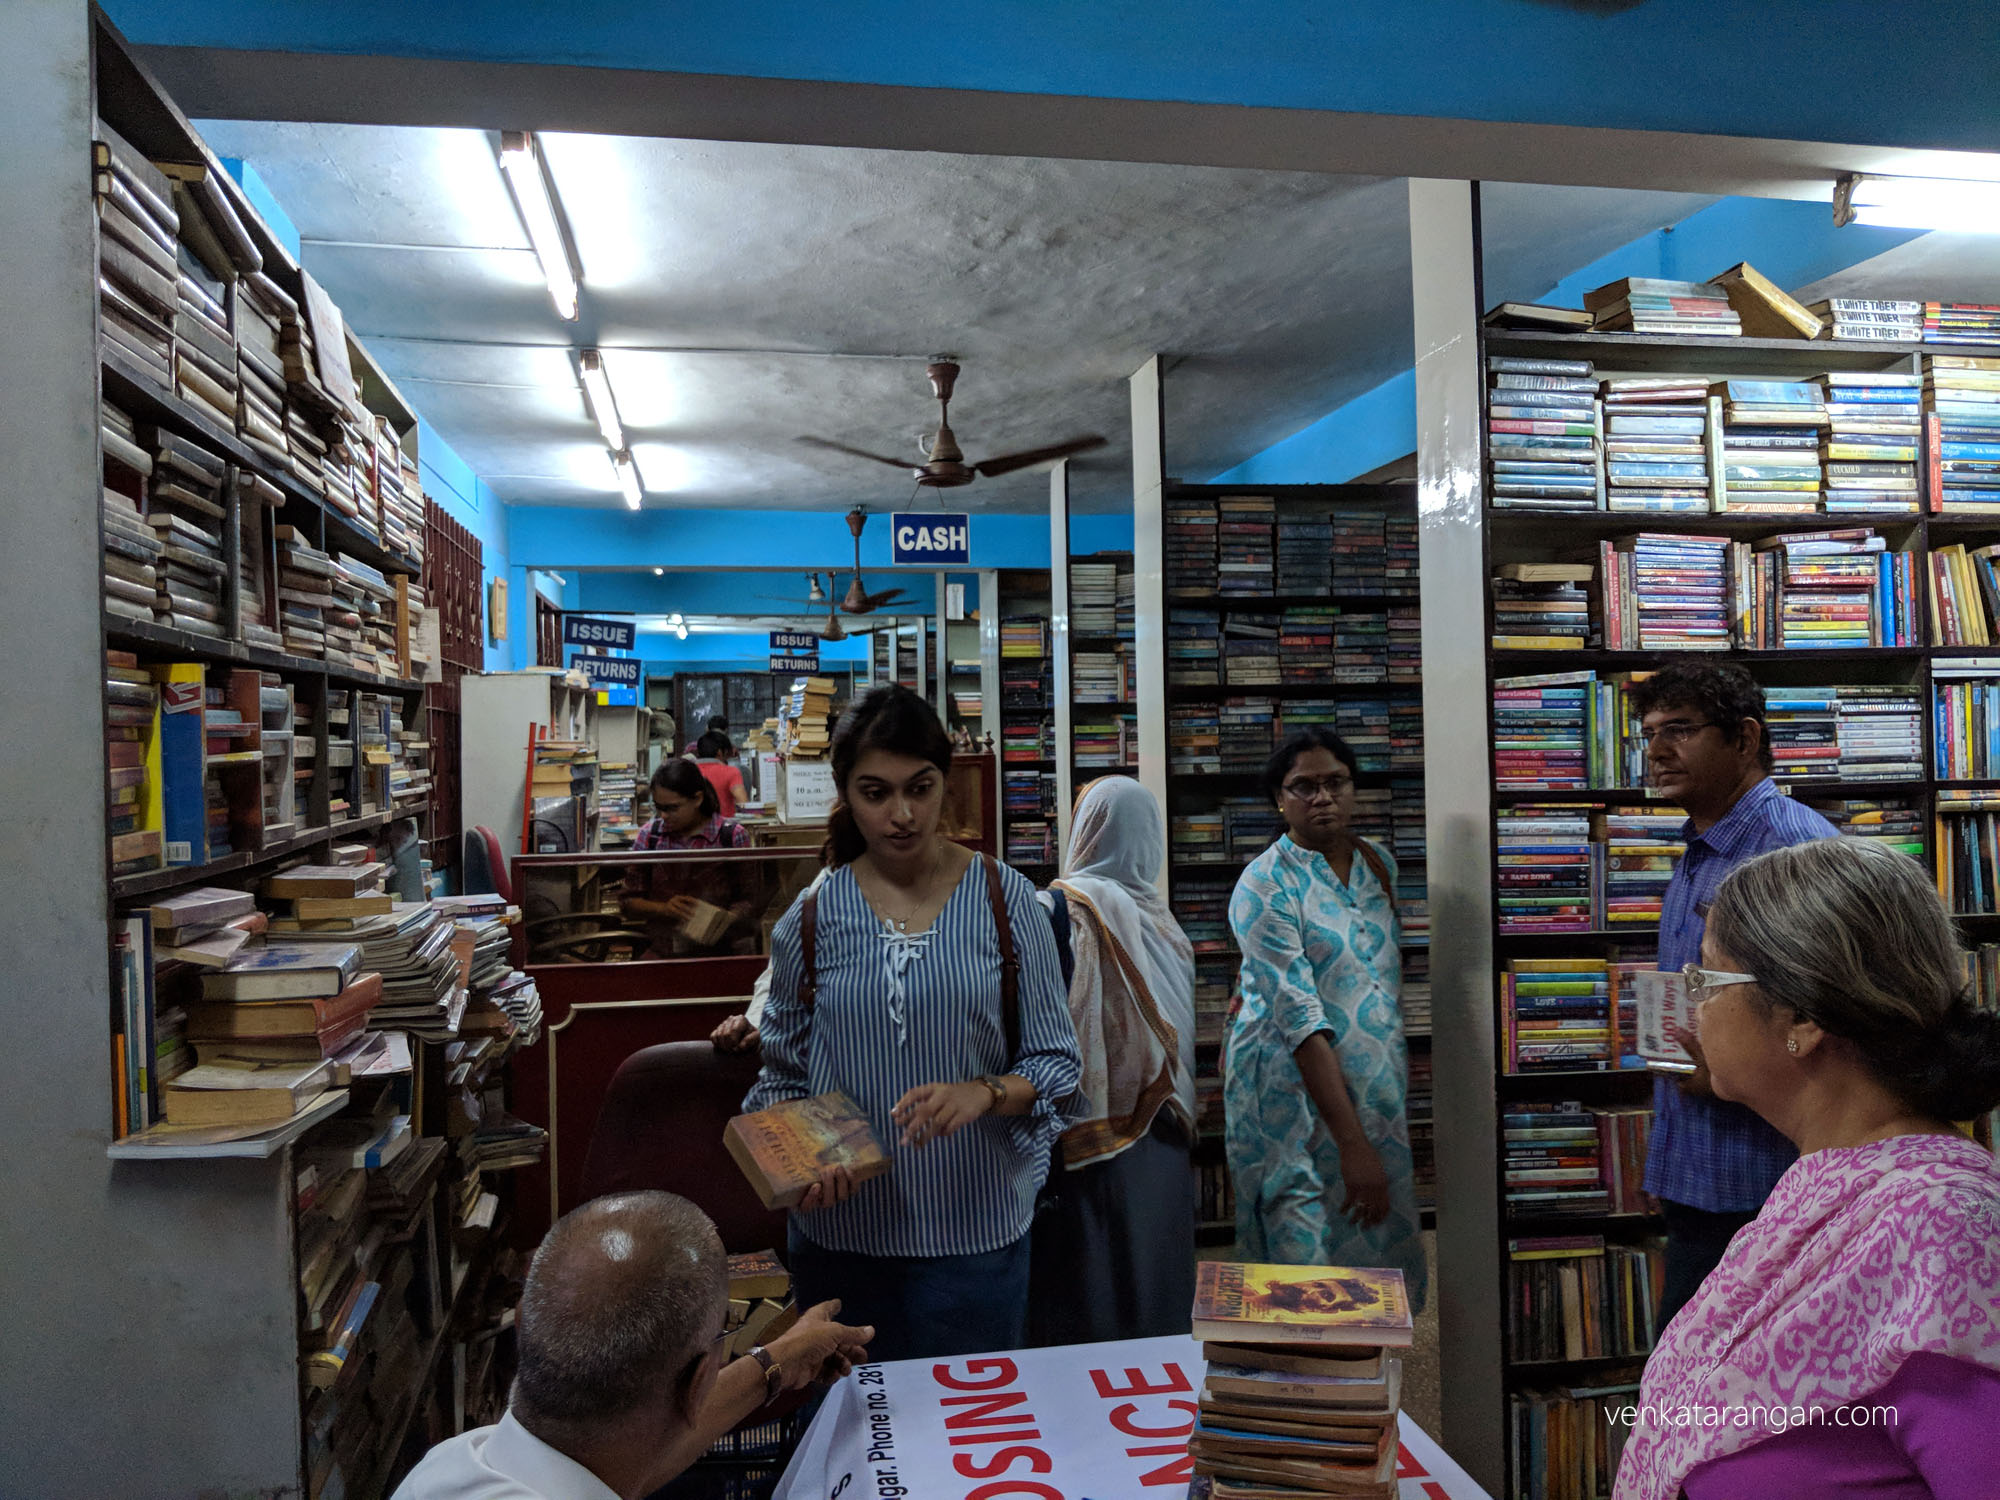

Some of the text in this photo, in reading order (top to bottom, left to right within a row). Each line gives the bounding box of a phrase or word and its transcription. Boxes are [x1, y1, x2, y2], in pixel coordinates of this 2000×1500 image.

[1842, 300, 1868, 311] WHITE
[1869, 301, 1898, 312] TIGER
[1845, 326, 1871, 338] WHITE
[1872, 327, 1900, 339] TIGER
[1518, 409, 1537, 418] ONE
[898, 526, 966, 551] CASH
[571, 623, 628, 644] ISSUE
[776, 635, 813, 646] ISSUE
[574, 660, 637, 680] RETURNS
[771, 658, 817, 671] RETURNS
[1535, 998, 1556, 1006] LOVE
[1662, 979, 1678, 1011] Ways
[1216, 1265, 1244, 1318] VEERAPPAN
[858, 1364, 909, 1500] gar. Phone no. 281
